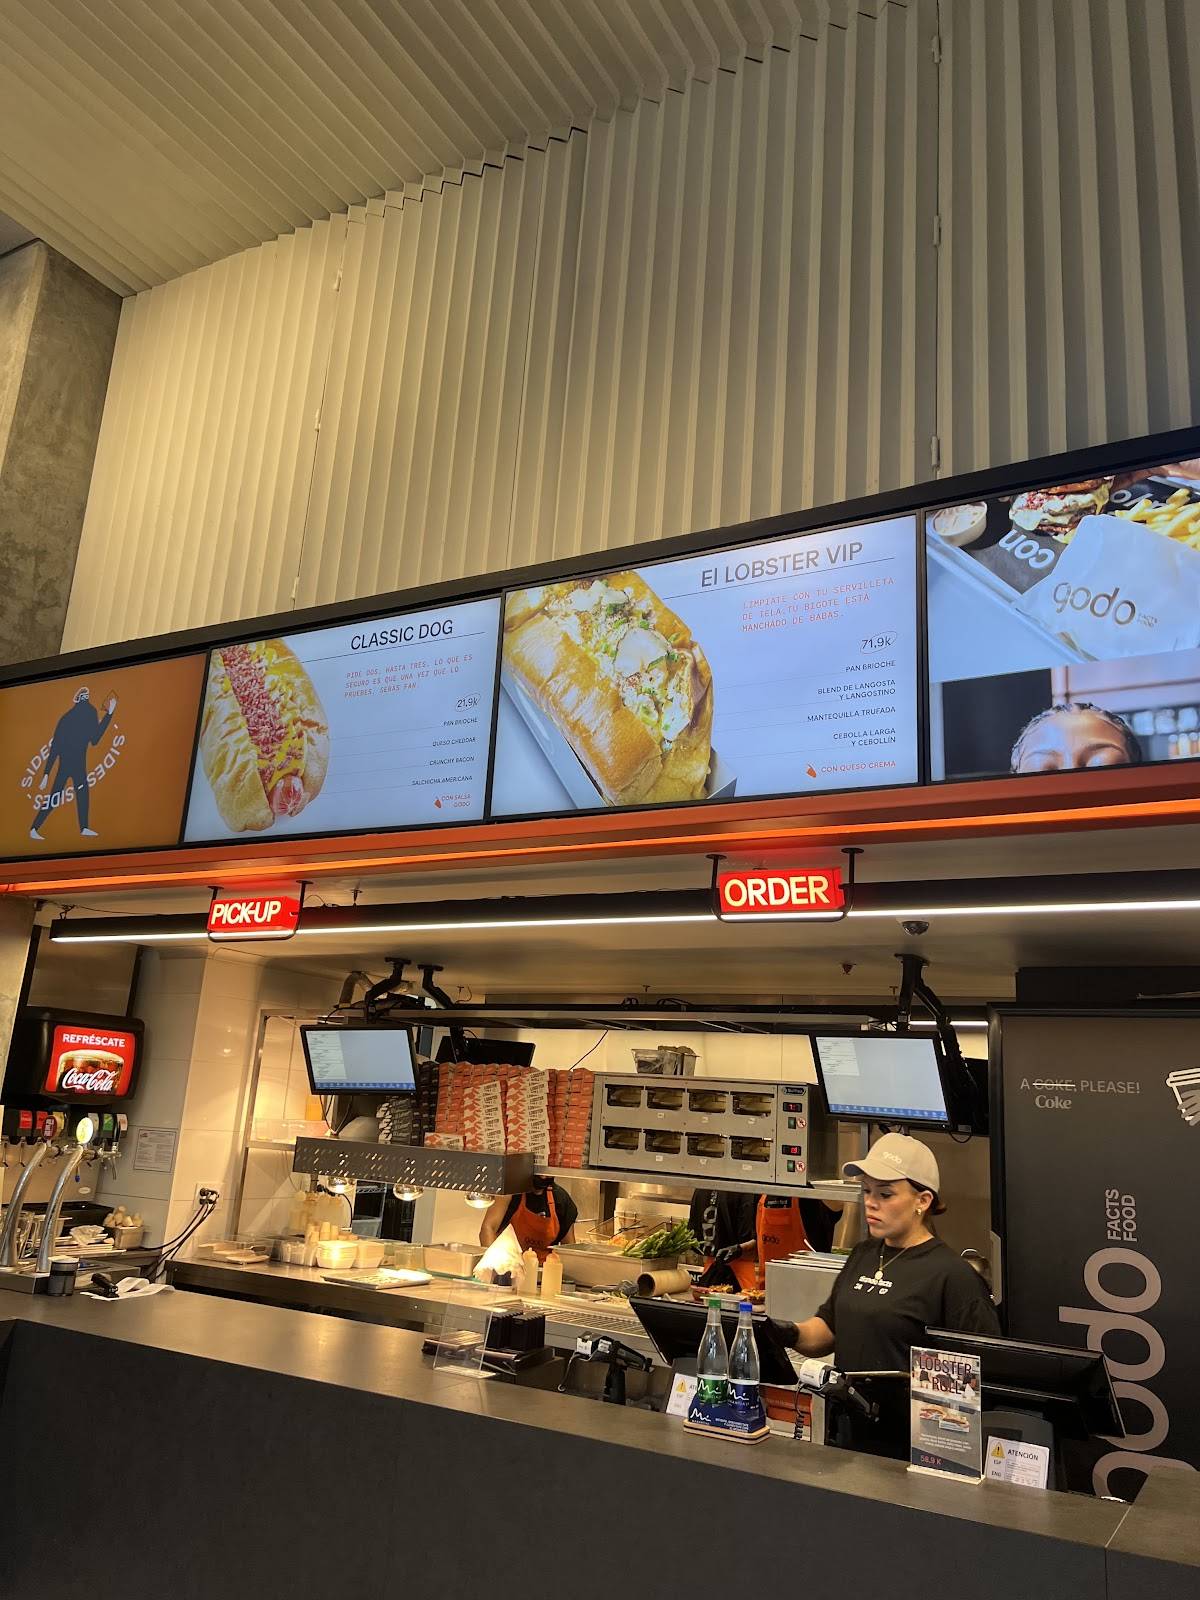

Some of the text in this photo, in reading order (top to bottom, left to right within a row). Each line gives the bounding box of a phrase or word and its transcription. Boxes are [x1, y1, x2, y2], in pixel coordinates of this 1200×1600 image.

[702, 542, 863, 587] El LOBSTER VIP
[794, 593, 810, 602] CON
[817, 589, 828, 597] TU
[833, 577, 895, 594] SERVILLETA
[743, 612, 753, 621] DE
[788, 605, 799, 613] TU
[805, 599, 839, 611] BIGOTE
[1053, 582, 1136, 625] godo
[743, 619, 787, 633] MANCHADO
[793, 616, 803, 625] DE
[351, 620, 453, 650] CLASSIC DOG
[447, 656, 460, 664] QUE
[846, 660, 896, 673] PAN BRIOCHE
[818, 686, 842, 695] BLEND
[855, 680, 896, 690] LANGOSTA
[846, 688, 896, 700] LANGOSTINO
[808, 706, 896, 722] MANTEQUILLA TRUFADA
[833, 728, 896, 740] CEBOLLA LARGA
[87, 735, 126, 787] SIDES
[840, 764, 867, 772] QUESO
[869, 761, 896, 769] CREMA
[33, 786, 74, 810] SIDES
[725, 876, 830, 907] ORDER
[211, 901, 282, 925] PICK-UP
[62, 1034, 126, 1048] REFRÉSCATE
[62, 1068, 119, 1092] Coca-Cola
[1021, 1078, 1031, 1090] A
[1081, 1080, 1141, 1094] PLEASE!
[1035, 1095, 1073, 1110] Coke
[1105, 1189, 1122, 1241] FACTS
[1121, 1194, 1138, 1242] FOOD
[919, 1355, 972, 1376] LOBSTER
[932, 1377, 962, 1395] ROLL
[1007, 1449, 1039, 1462] ATENCIÓN
